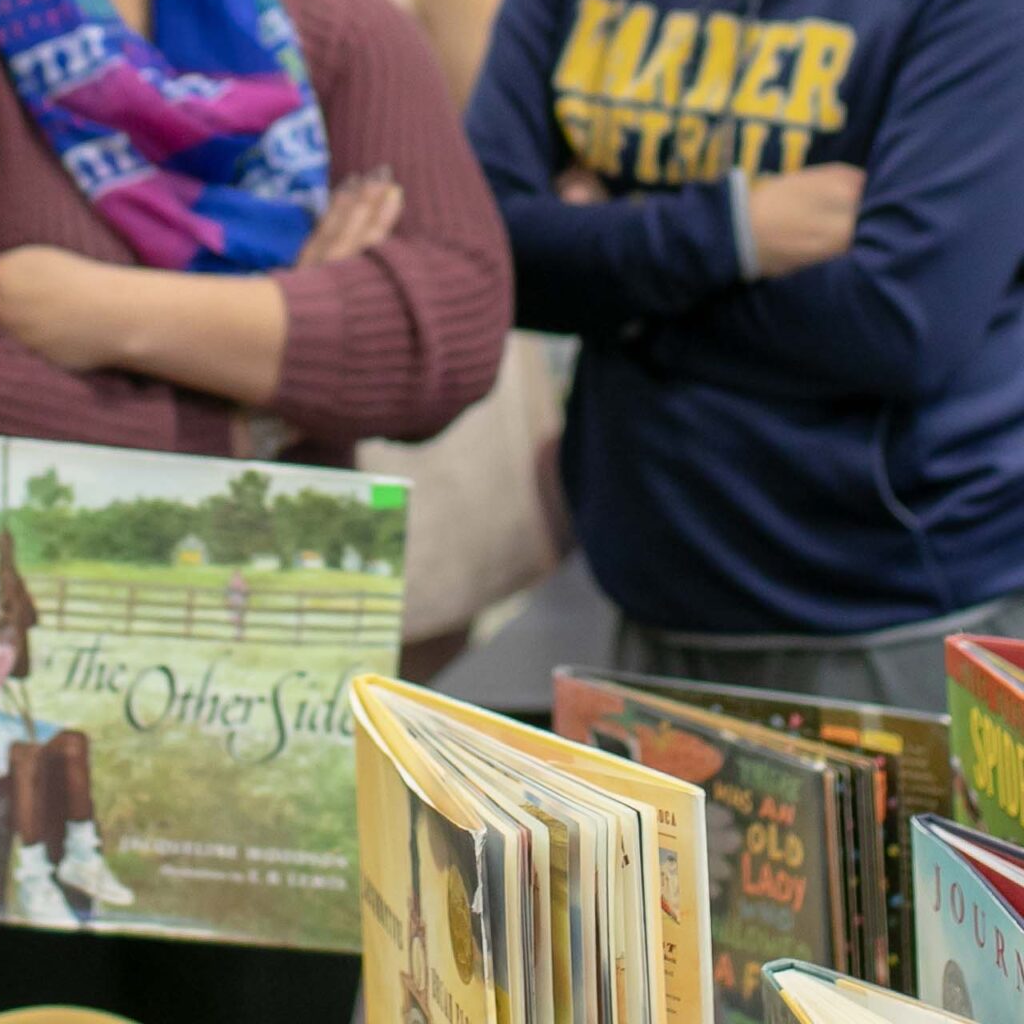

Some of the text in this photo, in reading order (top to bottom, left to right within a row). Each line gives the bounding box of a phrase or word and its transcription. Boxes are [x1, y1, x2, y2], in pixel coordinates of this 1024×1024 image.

[61, 633, 128, 695] The
[124, 660, 266, 733] Other
[745, 822, 805, 869] OLD
[740, 851, 807, 913] LADY
